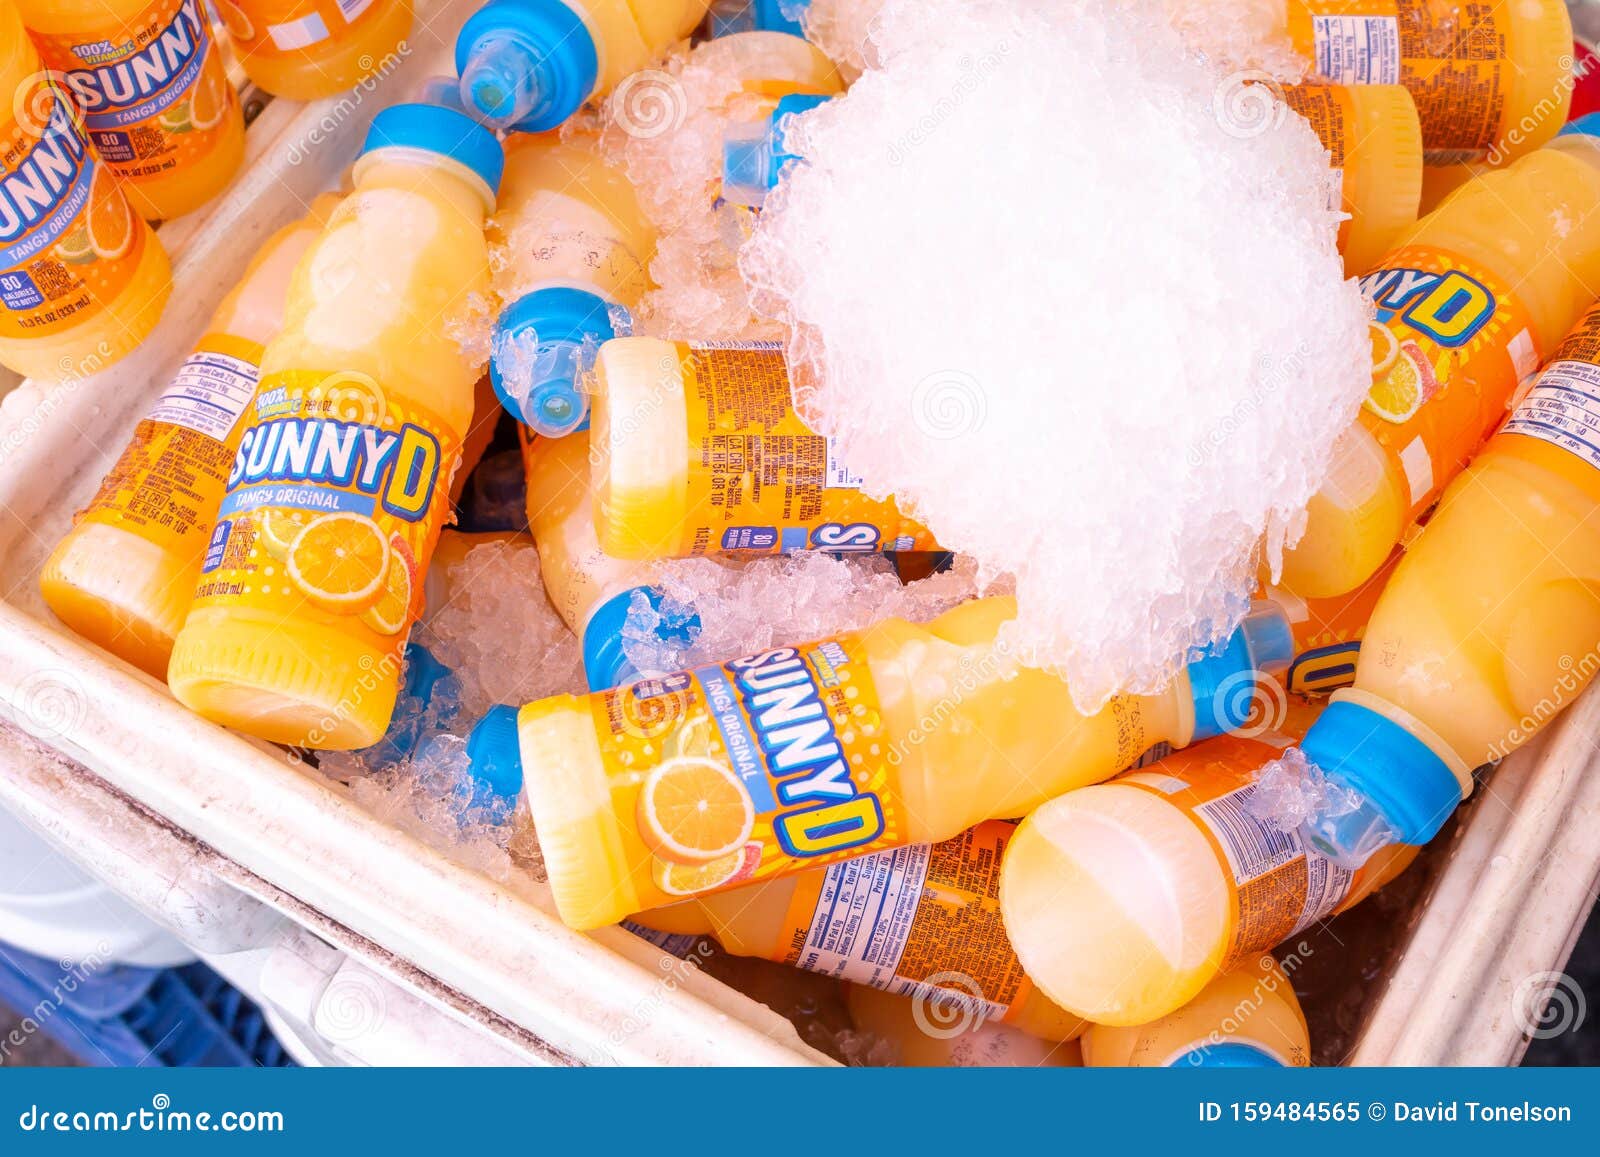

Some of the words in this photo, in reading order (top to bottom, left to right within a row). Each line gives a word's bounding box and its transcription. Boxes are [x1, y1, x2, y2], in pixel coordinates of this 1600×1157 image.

[115, 102, 156, 123] TANGY
[158, 62, 200, 107] ORIGINAL
[101, 133, 119, 146] 80
[0, 96, 81, 238] UNNY
[8, 230, 49, 262] TANGY
[49, 183, 88, 234] ORIGINAL
[1, 275, 21, 291] 80
[1359, 268, 1496, 347] NYD
[728, 438, 741, 449] CA
[713, 452, 725, 461] HI
[728, 452, 741, 470] CRV
[226, 418, 441, 522] SUNNYD
[711, 478, 725, 489] OR
[235, 489, 273, 509] TANGY
[276, 489, 340, 510] ORIGINAL
[711, 492, 723, 505] 10¢
[752, 534, 772, 544] 80
[704, 677, 730, 714] TANGY
[722, 714, 759, 781] ORIGINAL
[724, 646, 886, 859] SUNNYD
[845, 867, 858, 885] Total
[873, 867, 887, 893] Protein
[880, 856, 891, 866] 0g
[840, 890, 851, 903] 0%
[830, 927, 839, 938] Fat
[838, 935, 851, 955] Sodium
[853, 894, 864, 910] 11%
[790, 927, 807, 950] JUICE
[825, 938, 836, 951] Total
